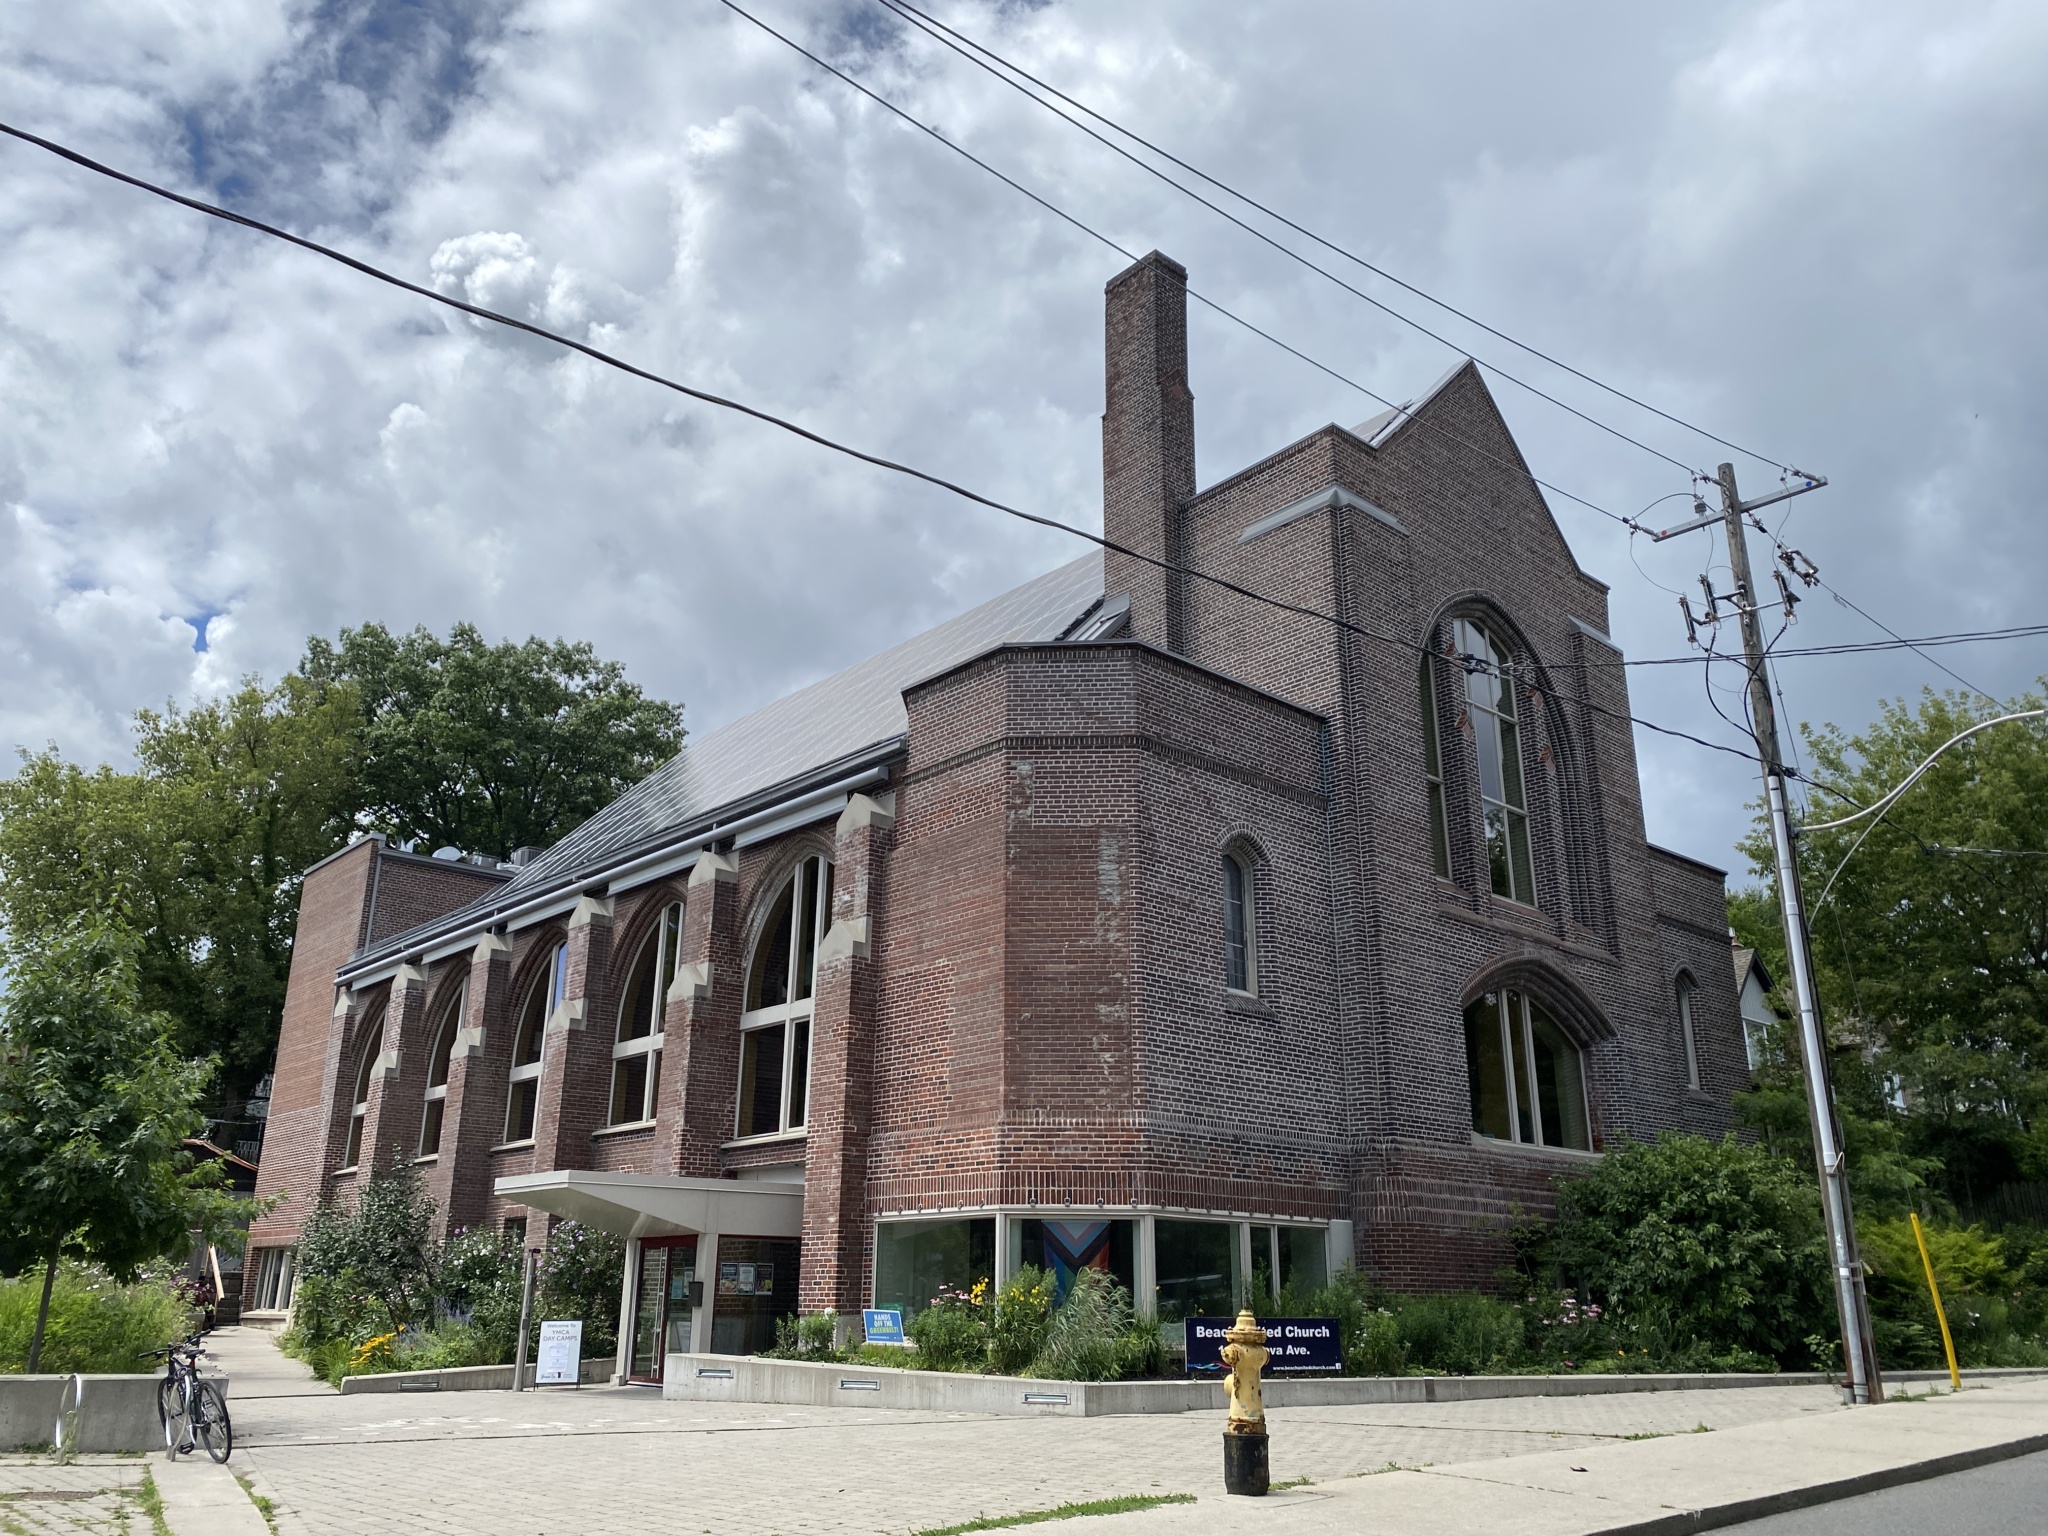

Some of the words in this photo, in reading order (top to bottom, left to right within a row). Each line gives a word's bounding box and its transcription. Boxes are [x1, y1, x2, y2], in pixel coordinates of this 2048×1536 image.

[1196, 1325, 1232, 1338] Beac
[1285, 1325, 1330, 1338] Church
[1286, 1344, 1311, 1356] Ave.
